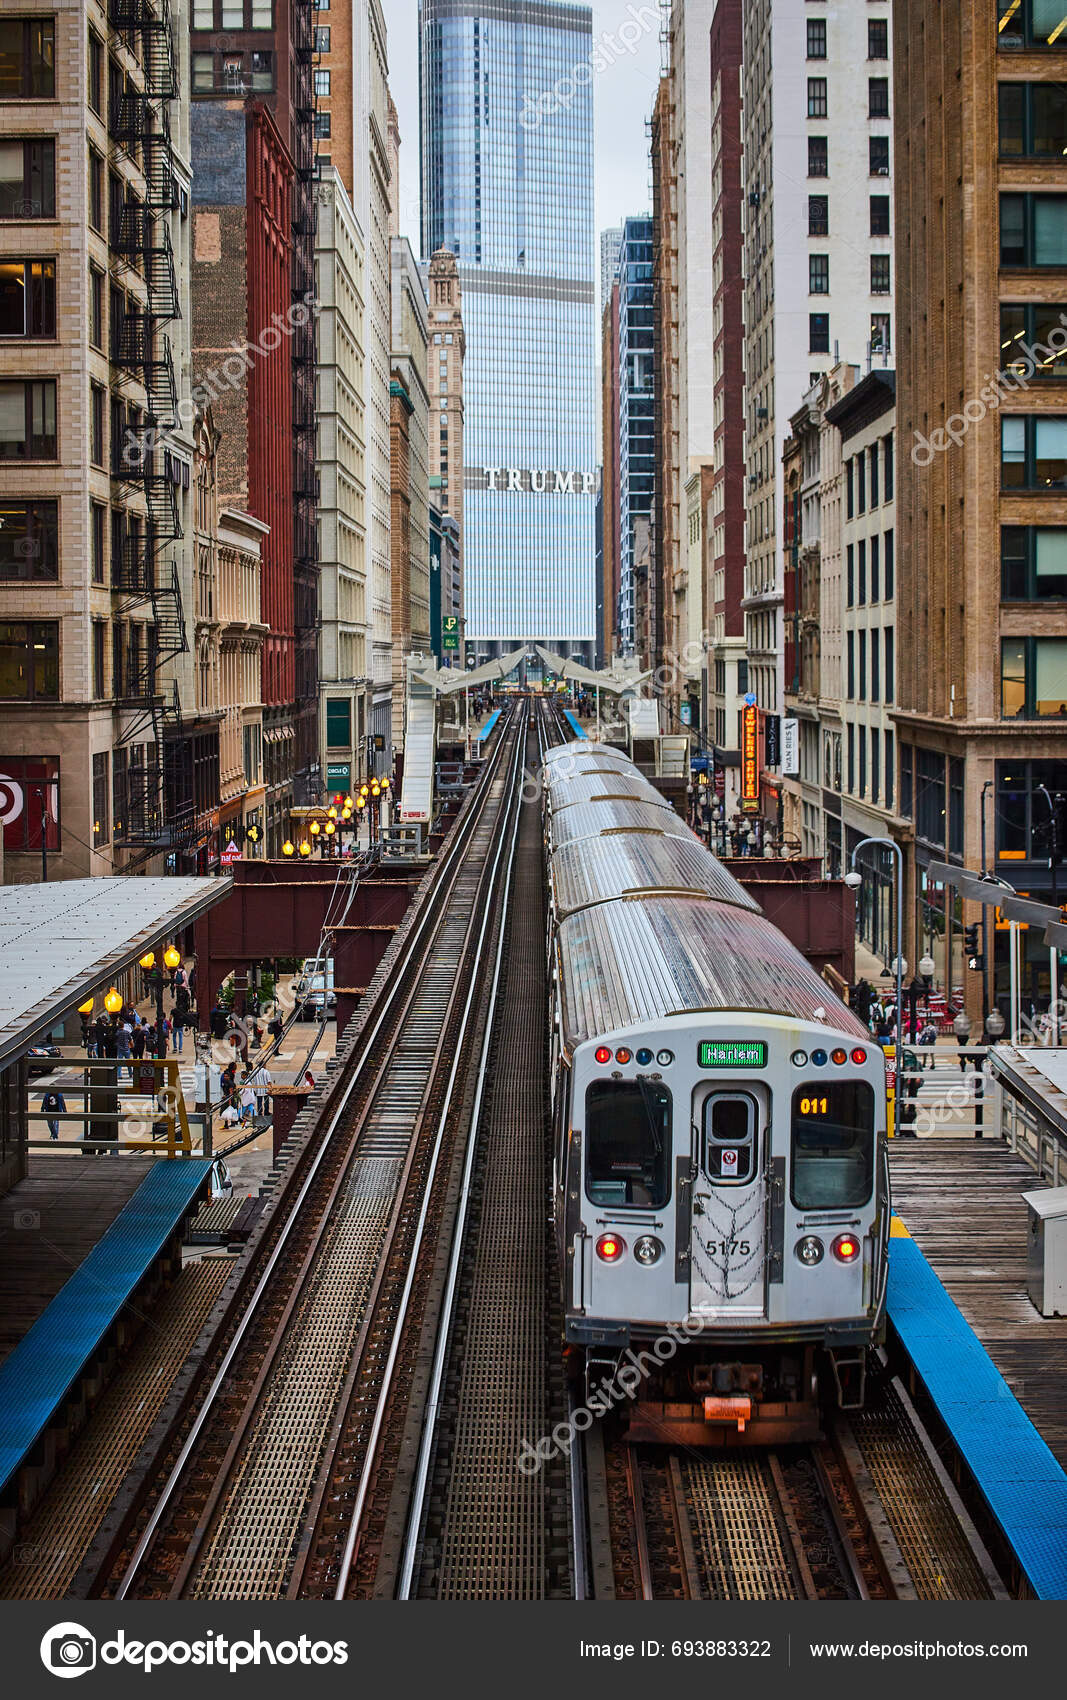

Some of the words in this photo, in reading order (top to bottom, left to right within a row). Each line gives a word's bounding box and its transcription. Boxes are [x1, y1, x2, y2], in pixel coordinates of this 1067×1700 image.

[483, 467, 596, 494] TRUMP
[745, 707, 756, 759] JEWELERS
[707, 1047, 759, 1060] Harlem
[800, 1098, 827, 1114] 011
[706, 1240, 751, 1256] 5175
